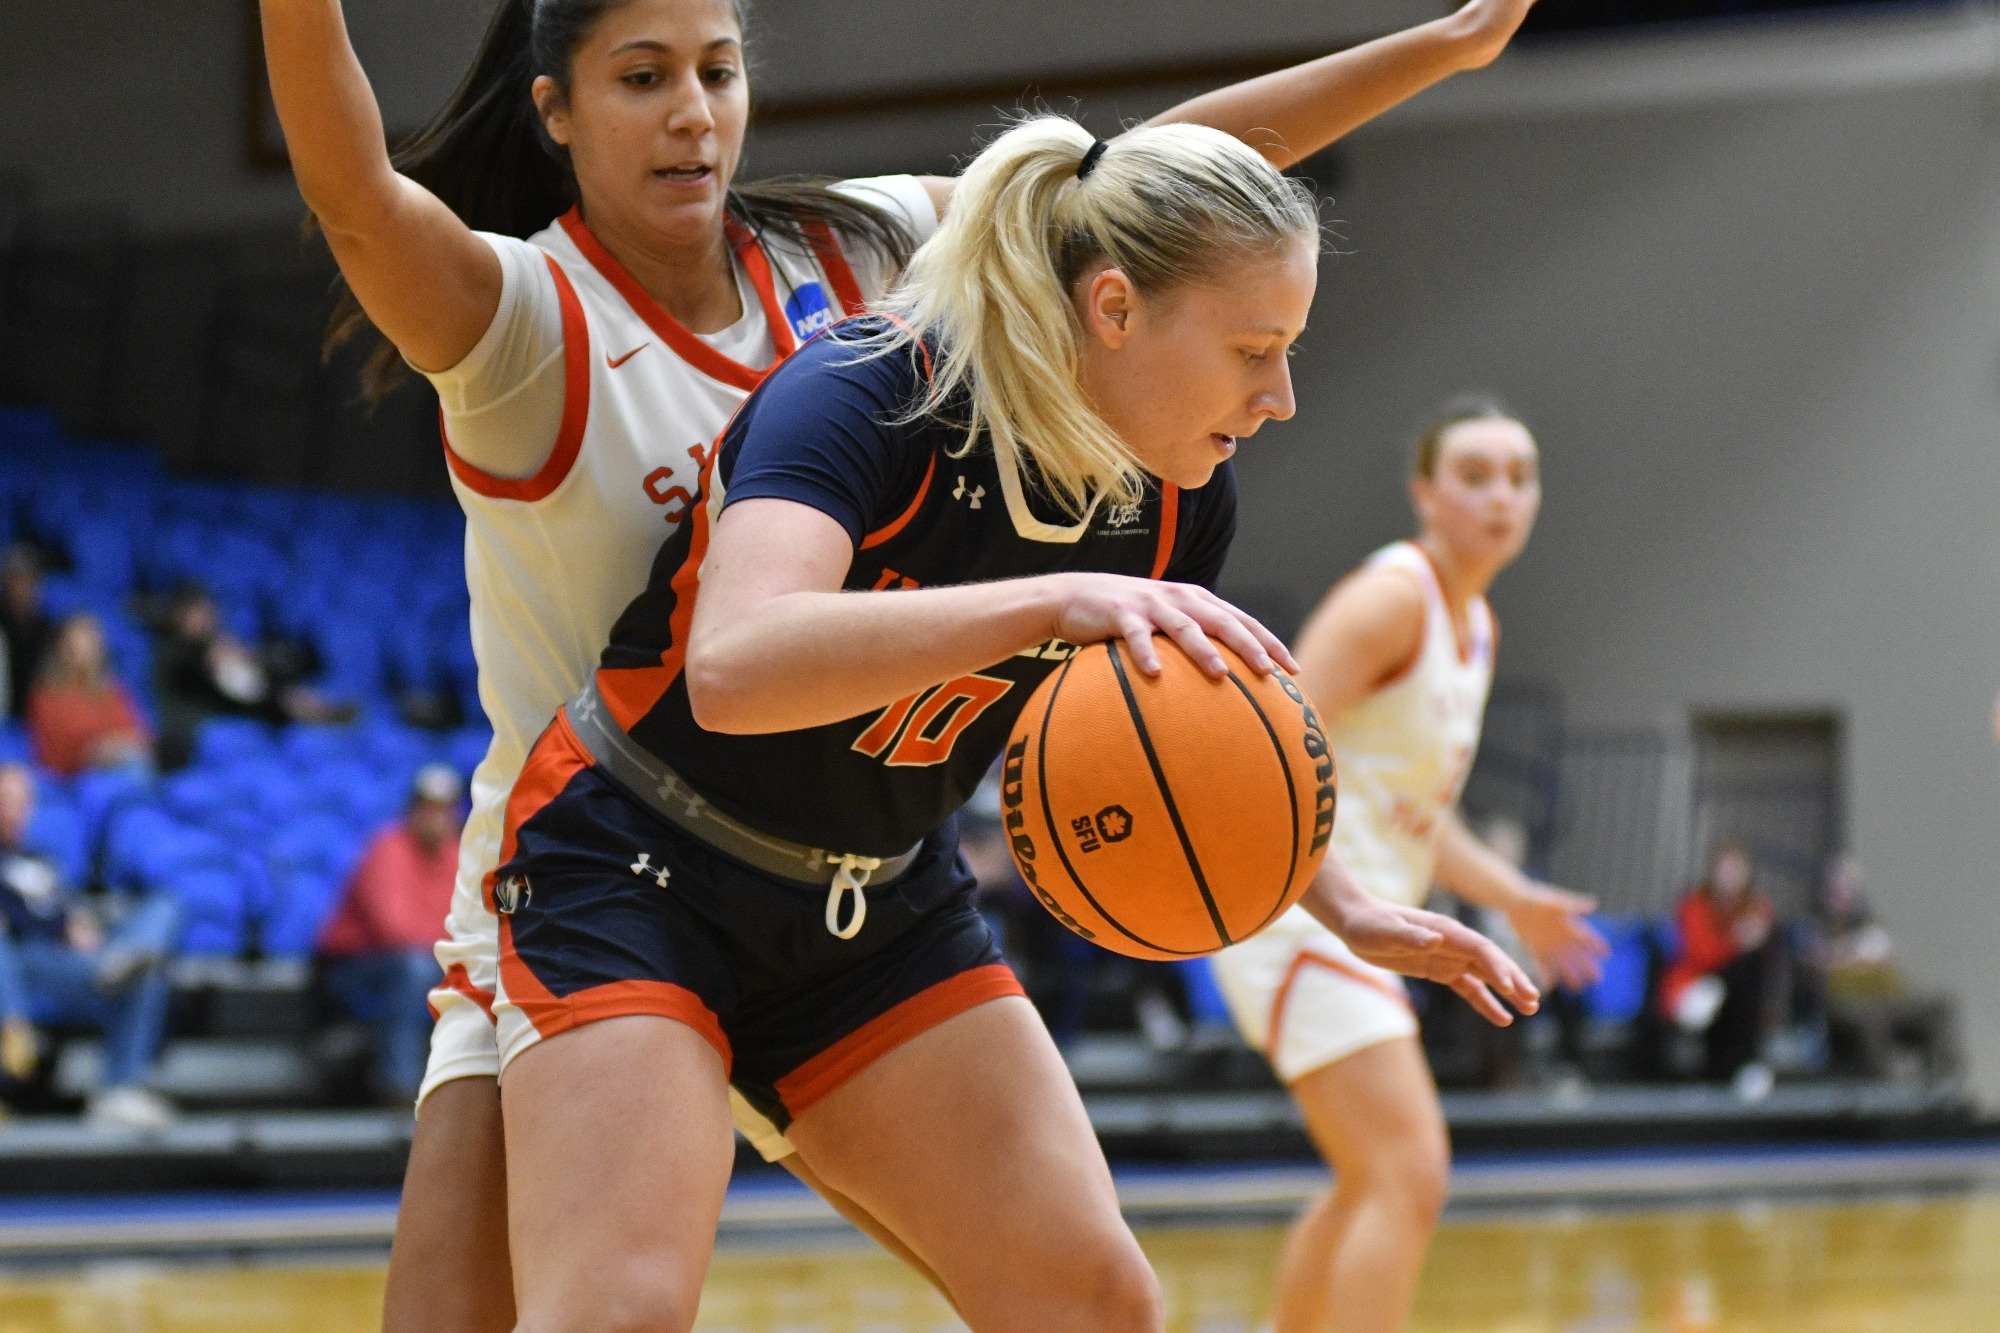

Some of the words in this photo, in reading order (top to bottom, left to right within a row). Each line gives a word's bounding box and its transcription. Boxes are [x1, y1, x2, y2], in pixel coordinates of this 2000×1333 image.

[850, 672, 1016, 767] 10
[1003, 735, 1096, 939] Wilson
[1071, 814, 1101, 854] SFU
